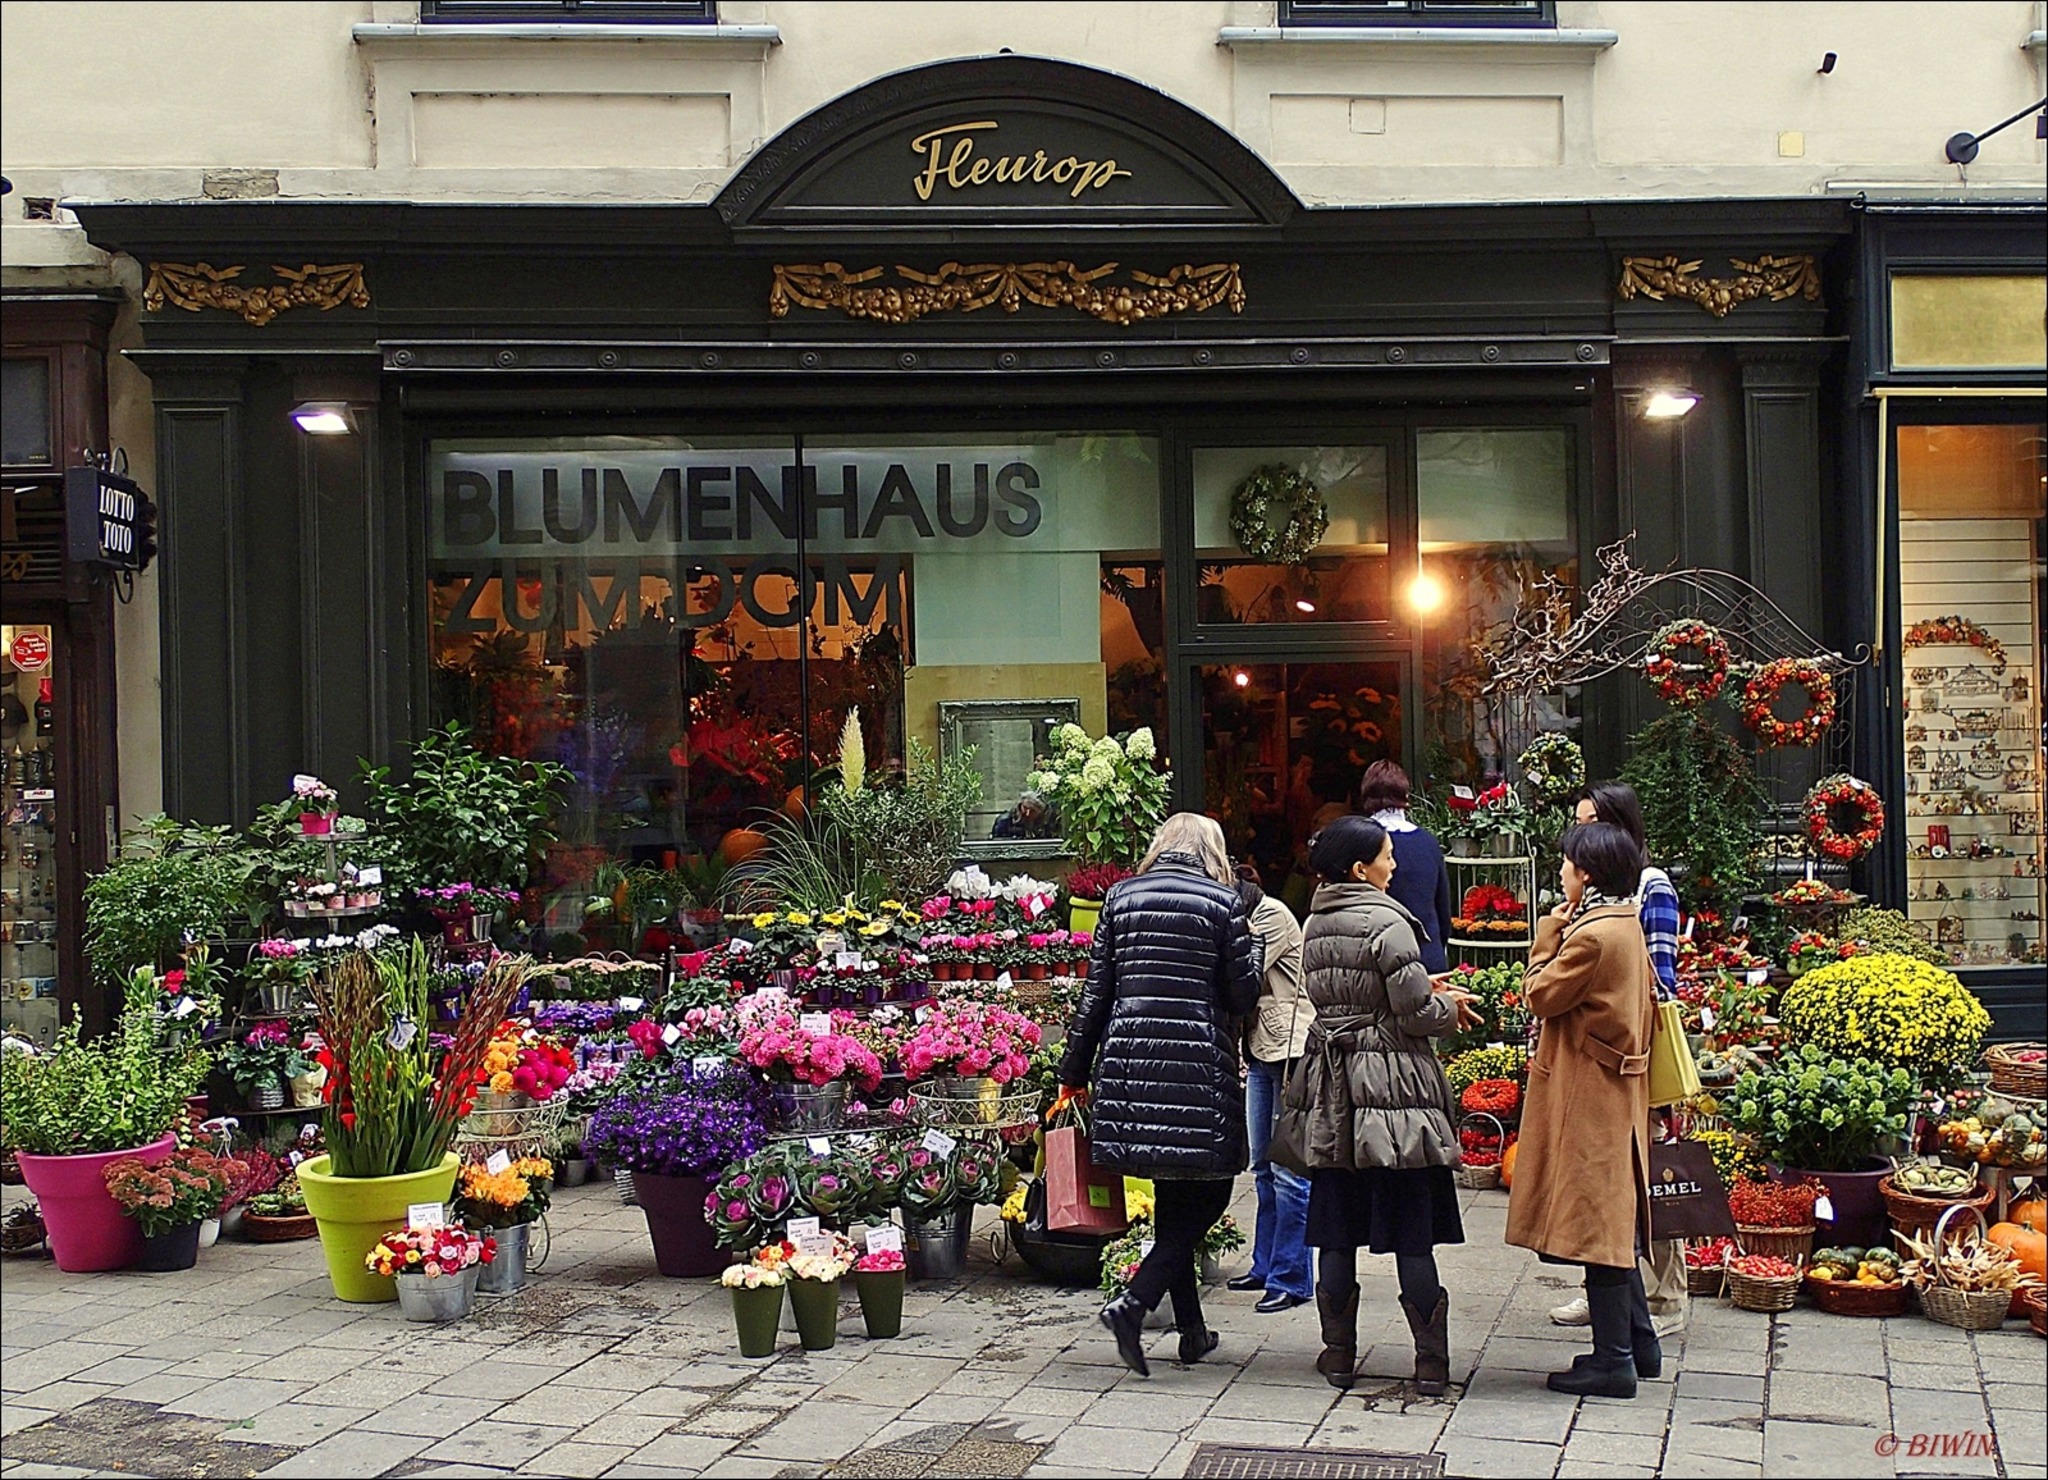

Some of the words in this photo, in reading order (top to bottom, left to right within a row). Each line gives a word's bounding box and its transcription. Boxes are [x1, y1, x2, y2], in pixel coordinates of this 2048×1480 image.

[911, 121, 1133, 201] Fleurop
[99, 485, 134, 522] LOTTO
[103, 520, 132, 554] TOTO
[443, 463, 1041, 545] BLUMENHAUS
[446, 552, 640, 634] ZUM
[680, 552, 900, 630] DOM
